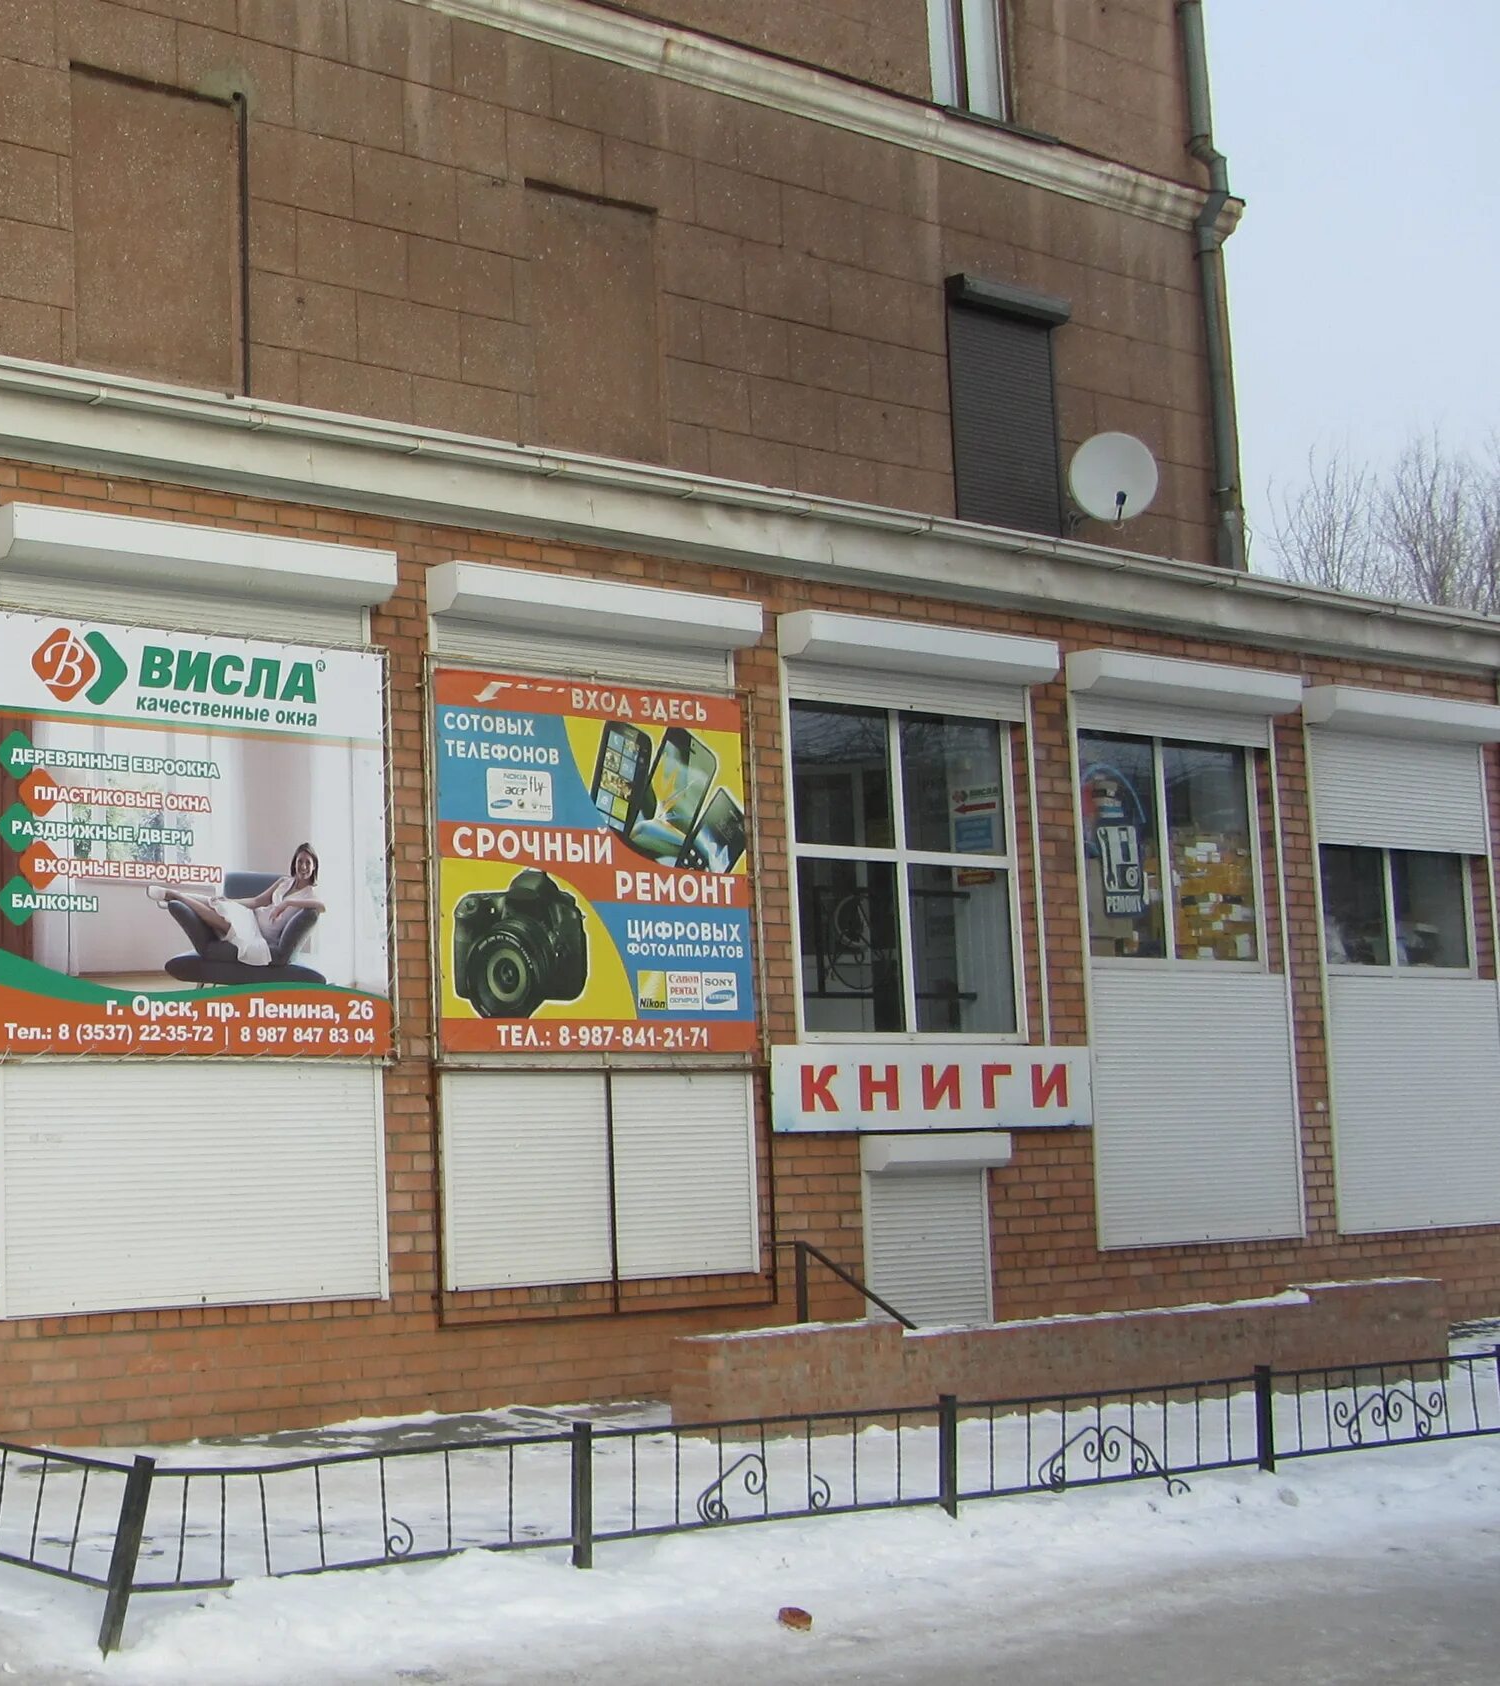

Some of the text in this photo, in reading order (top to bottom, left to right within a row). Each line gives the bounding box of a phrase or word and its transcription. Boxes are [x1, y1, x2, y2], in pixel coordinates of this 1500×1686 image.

[138, 645, 318, 704] ВИСЛА
[136, 695, 318, 727] качественные окна
[571, 688, 708, 722] ВХОД ЗДЕСЬ
[443, 712, 535, 737] СОТОВЫХ
[10, 747, 221, 780] ДЕРЕВЯННЫЕ ЕВРООКНА
[444, 739, 560, 765] ТЕЛЕФОНОВ
[33, 785, 212, 813] ПЛАСТИКОВЫЕ ОКНА
[504, 786, 528, 796] acer
[11, 820, 194, 847] РАЗДВИЖНЫЕ ДВЕРИ
[452, 825, 613, 865] СРОЧНЫЙ
[34, 857, 222, 884] ВХОДНЫЕ ЕВРОДВЕРИ
[615, 871, 736, 905] РЕМОНТ
[11, 892, 99, 913] БАЛКОНЫ
[1106, 895, 1142, 914] РЕМОНТ
[627, 919, 741, 943] ЦИФРОВЫХ
[626, 942, 744, 959] ФОТОАППАРАТОВ
[668, 974, 699, 984] Canon
[670, 986, 698, 995] PENTAX
[704, 978, 734, 987] SONY
[106, 993, 374, 1023] г. Орск, пр. Ленина, 26
[639, 998, 666, 1009] Nikon
[4, 1023, 213, 1043] Тел.: 8 (3537) 22-35-72
[240, 1026, 375, 1043] 8 987 847 83 04
[497, 1025, 709, 1048] ТЕЛ.: 8-987-841-21-71
[800, 1062, 1069, 1113] КНИГИ
